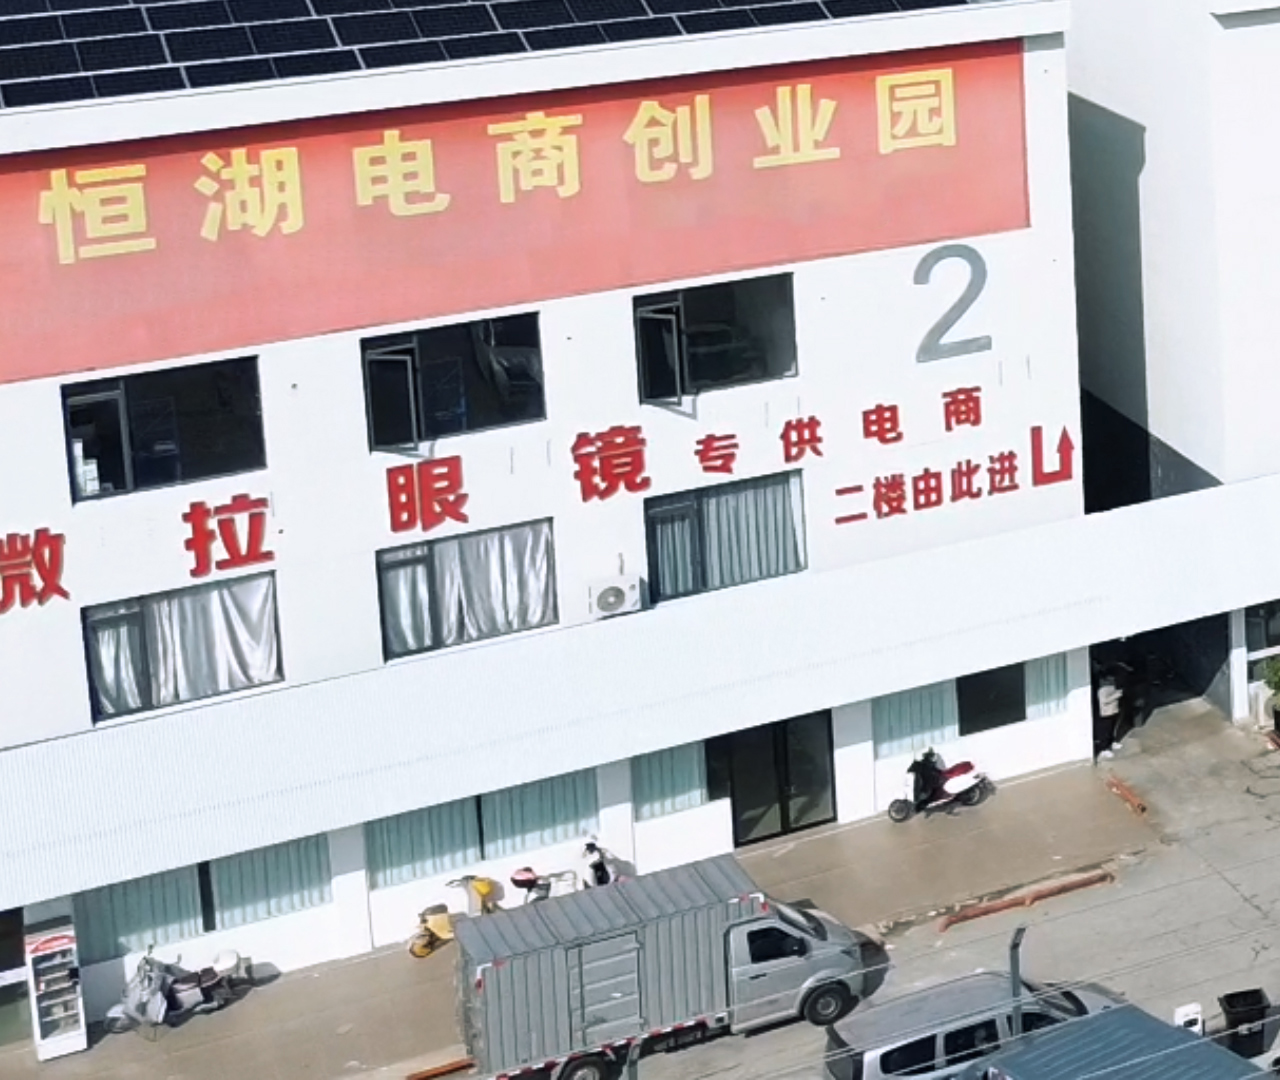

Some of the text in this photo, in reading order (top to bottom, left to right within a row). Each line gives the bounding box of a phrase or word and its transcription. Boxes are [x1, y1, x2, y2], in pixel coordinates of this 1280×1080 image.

[38, 67, 957, 264] 恒湖电商创业园
[912, 243, 993, 363] 2
[695, 386, 983, 476] 专供电商
[834, 450, 1019, 525] 二楼由此进
